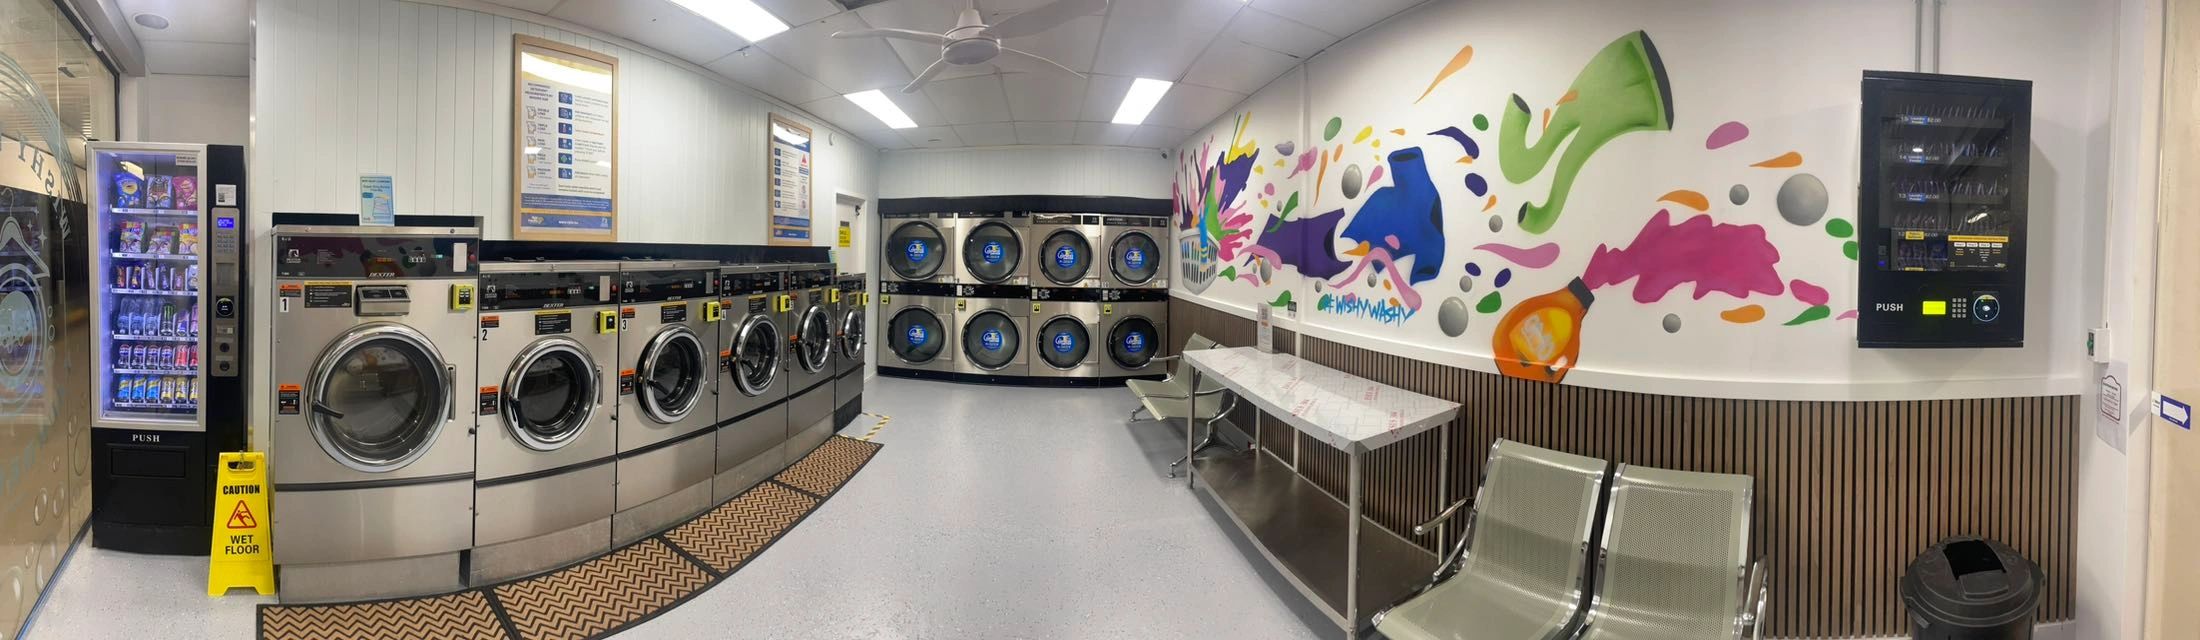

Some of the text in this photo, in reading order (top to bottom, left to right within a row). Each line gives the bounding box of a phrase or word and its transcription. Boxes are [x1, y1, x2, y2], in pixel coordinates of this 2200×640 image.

[281, 298, 287, 311] 1
[1875, 303, 1904, 312] PUSH
[622, 319, 627, 330] 3
[482, 329, 488, 341] 2
[132, 434, 160, 443] PUSH
[223, 485, 260, 495] CAUTION
[230, 534, 254, 545] WET
[225, 544, 260, 555] FLOOR
